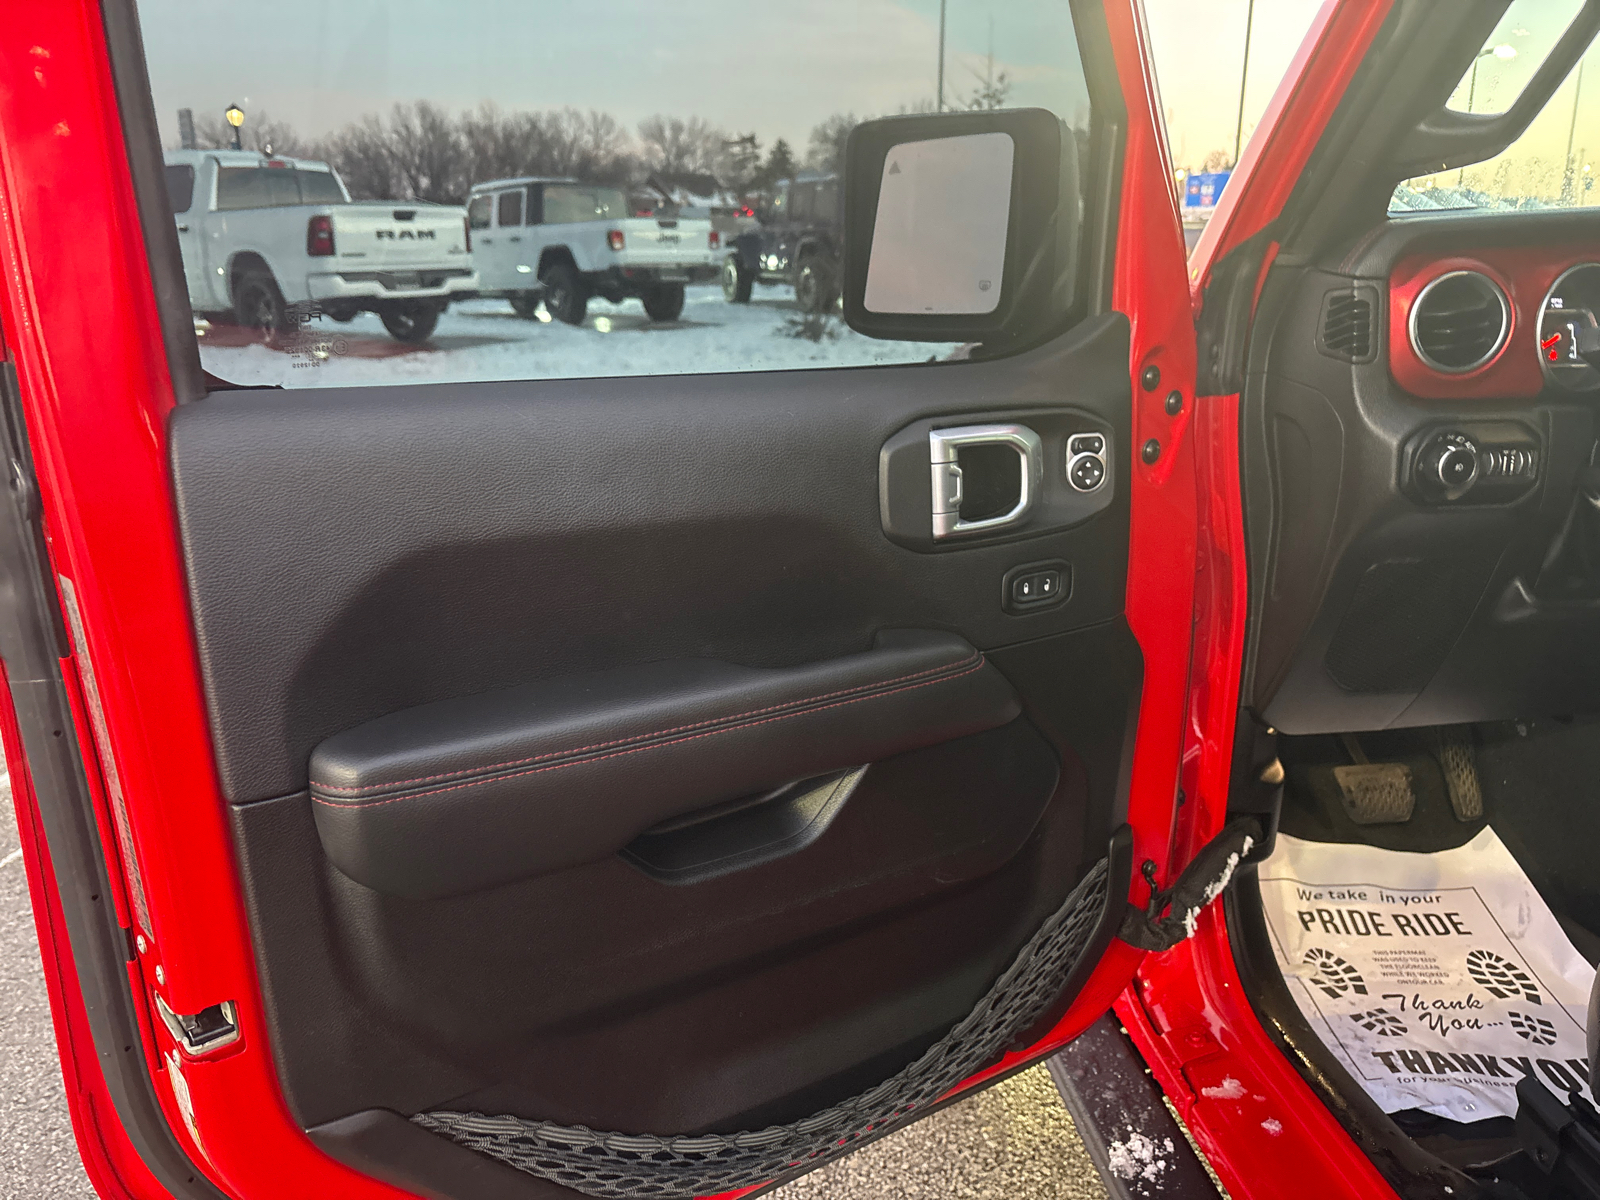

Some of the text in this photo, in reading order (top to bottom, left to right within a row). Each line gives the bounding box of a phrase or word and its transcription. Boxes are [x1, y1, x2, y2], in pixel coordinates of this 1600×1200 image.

[376, 230, 435, 240] RAM
[1297, 887, 1442, 906] We take in your
[1297, 908, 1473, 936] PRIDE RIDE
[1381, 993, 1484, 1012] Thank
[1397, 1076, 1417, 1084] for
